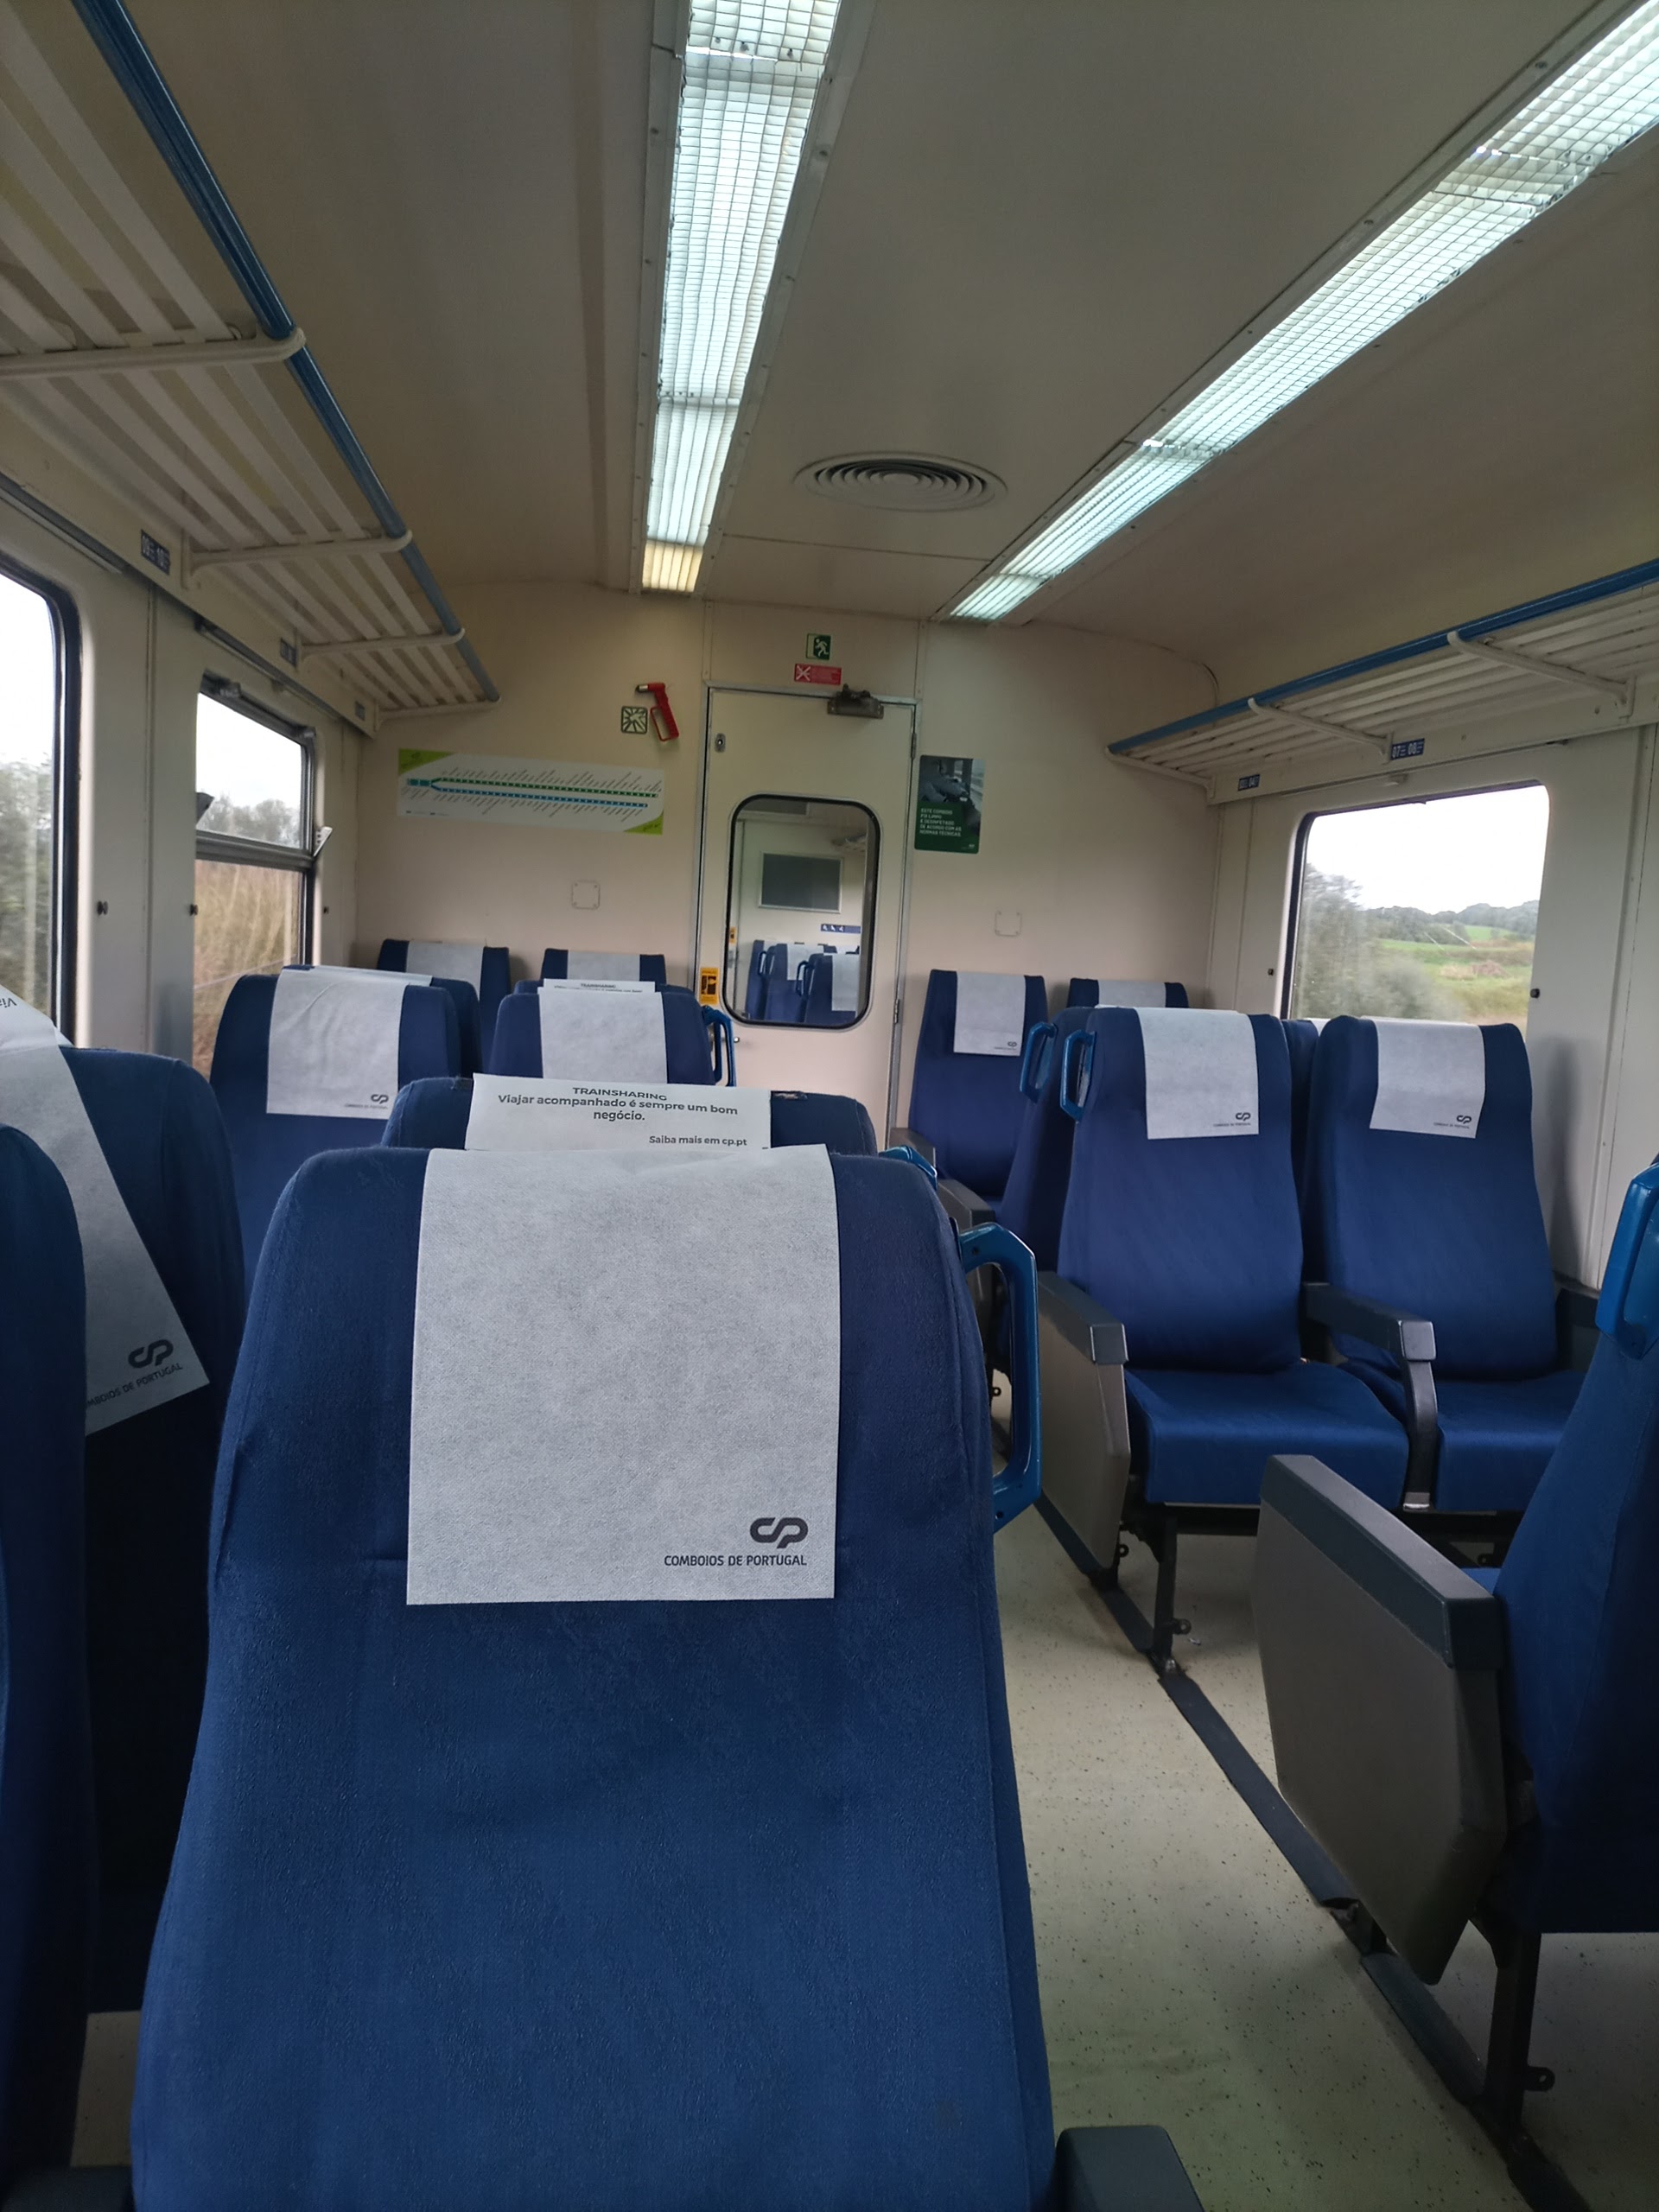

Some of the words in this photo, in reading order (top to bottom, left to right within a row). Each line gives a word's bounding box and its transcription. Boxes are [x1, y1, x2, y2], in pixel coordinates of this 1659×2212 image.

[572, 1087, 667, 1101] TRAINSHARING
[498, 1094, 534, 1105] Viajar
[537, 1096, 626, 1107] acompanhado
[639, 1101, 685, 1110] sempre
[710, 1105, 738, 1115] bom
[594, 1110, 645, 1122] negócio.
[649, 1135, 676, 1144] Saiba
[678, 1135, 702, 1144] mais
[87, 1388, 121, 1408] MBOIOS
[122, 1382, 134, 1393] DE
[136, 1363, 182, 1388] PORTUGAL
[664, 1555, 724, 1567] COMBOIOS
[728, 1555, 743, 1567] DE
[746, 1554, 807, 1567] PORTUGAL
